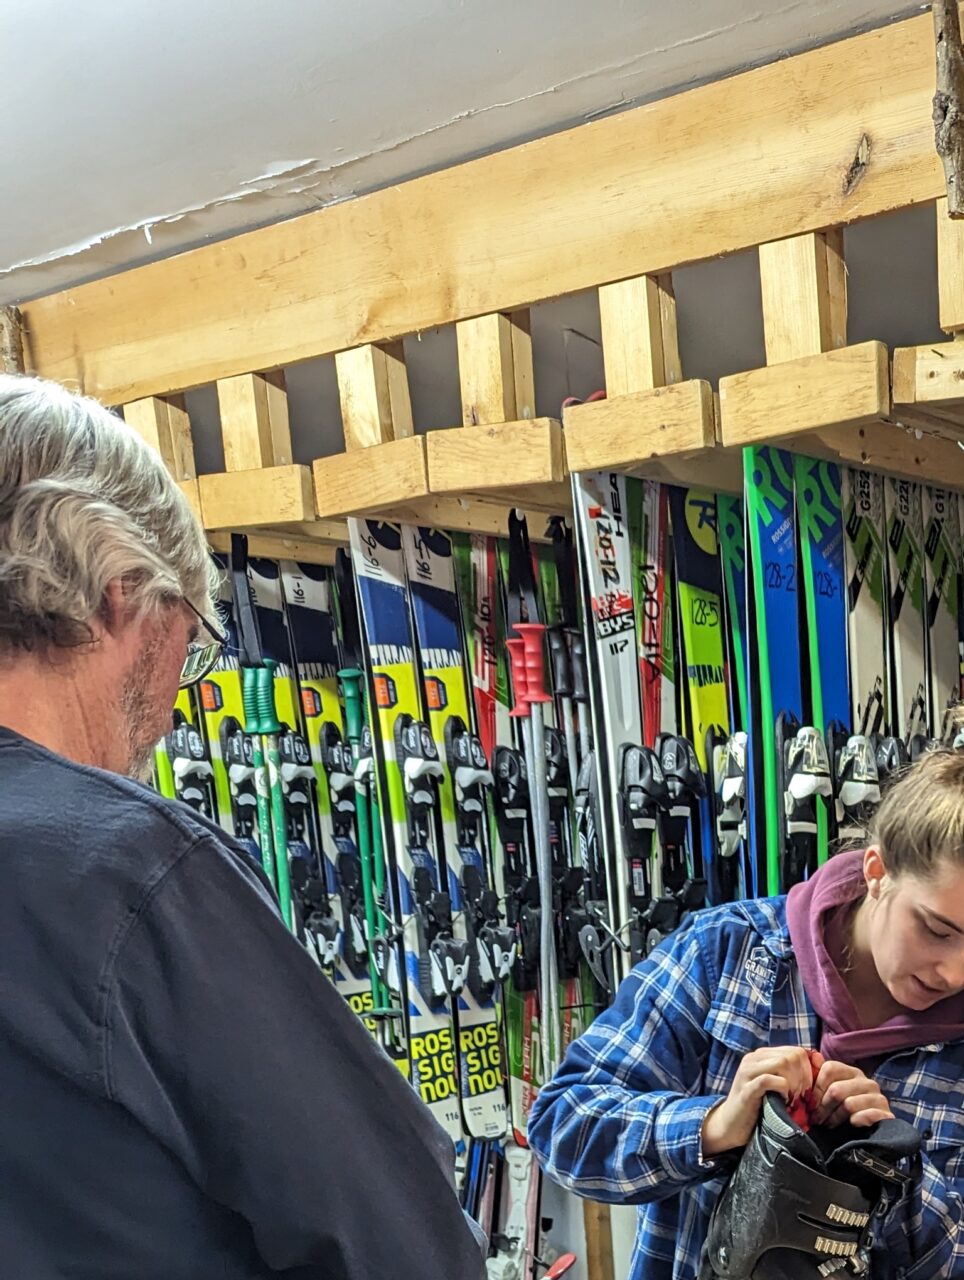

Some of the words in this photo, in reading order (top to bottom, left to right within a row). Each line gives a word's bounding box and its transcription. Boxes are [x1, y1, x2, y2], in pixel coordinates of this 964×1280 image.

[609, 473, 624, 538] HEA
[360, 533, 383, 577] 116-6
[413, 533, 433, 581] 116-5
[291, 575, 306, 604] 116-1
[690, 597, 720, 628] 128-5
[609, 638, 629, 656] 117
[411, 1029, 452, 1060] ROS
[460, 1022, 498, 1052] ROS
[418, 1052, 456, 1081] SIG
[466, 1045, 501, 1073] SIG
